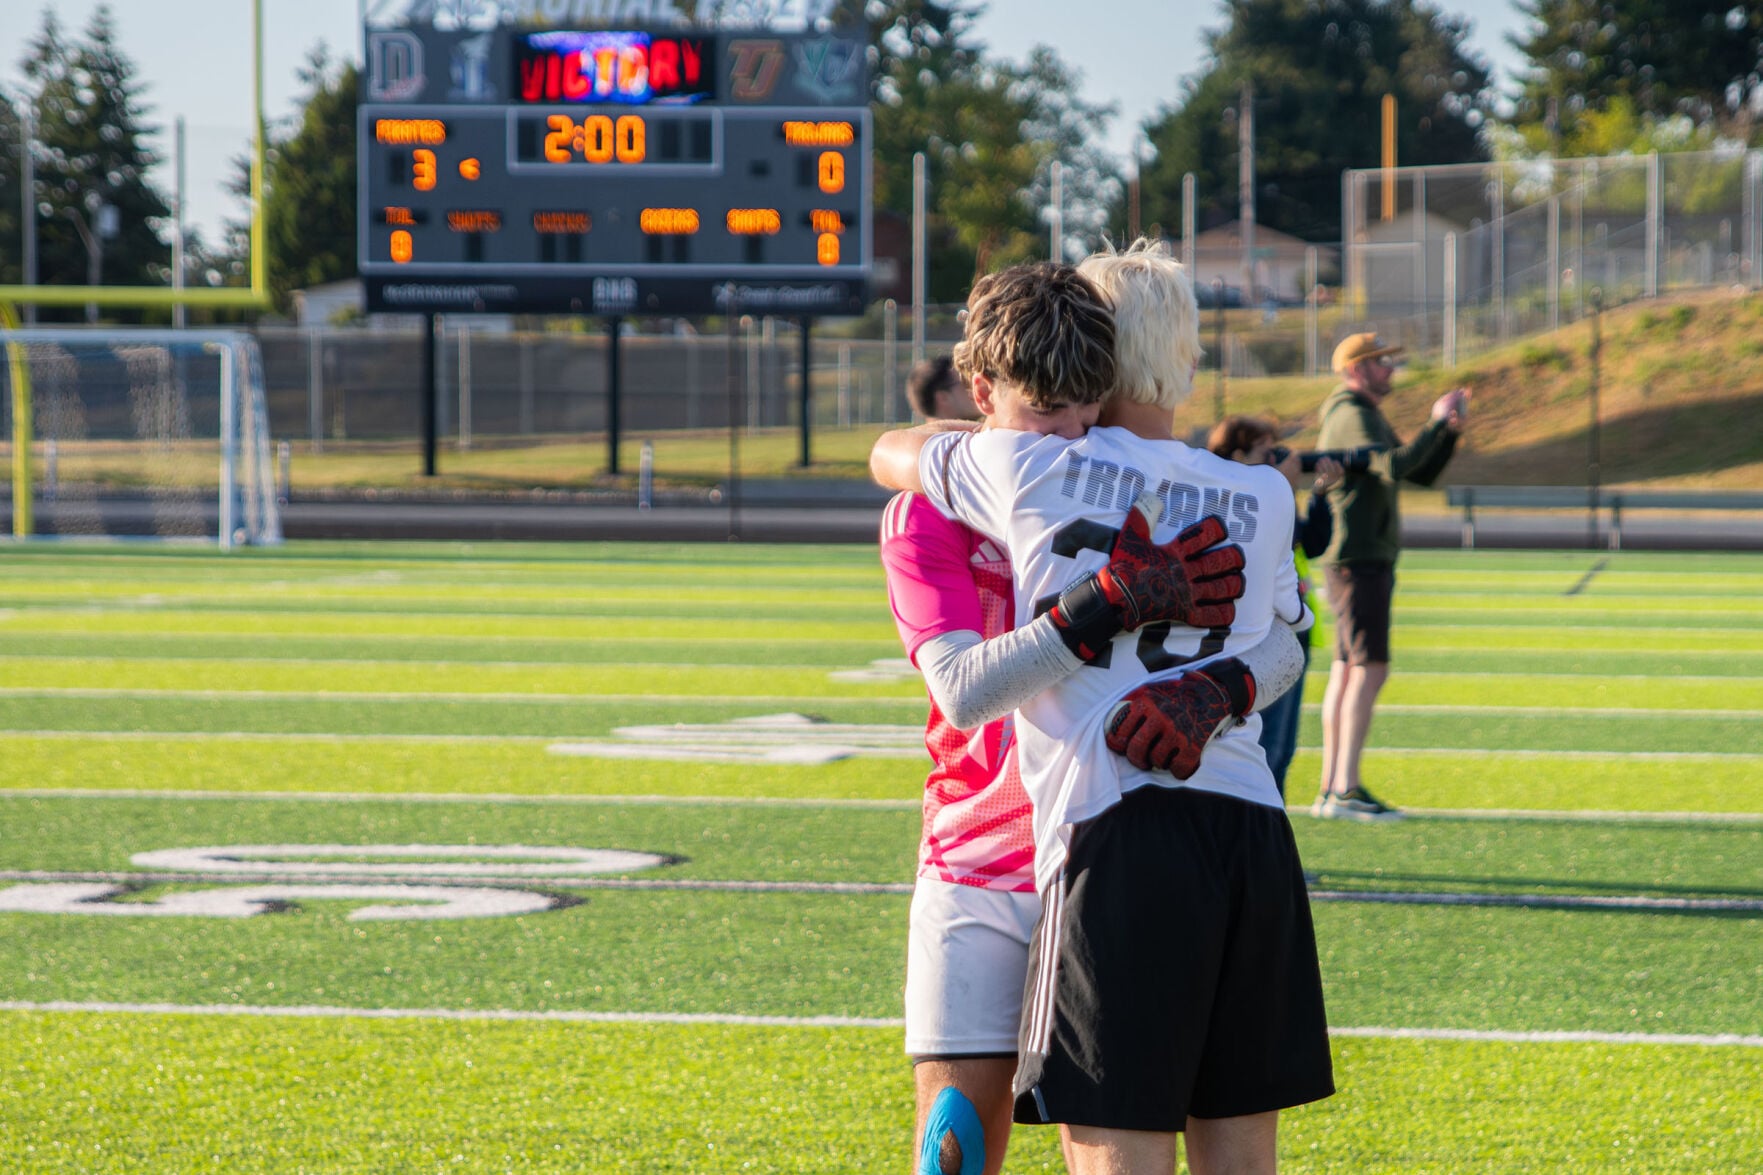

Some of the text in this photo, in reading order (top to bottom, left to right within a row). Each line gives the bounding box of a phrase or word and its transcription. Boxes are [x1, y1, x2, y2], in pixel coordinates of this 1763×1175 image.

[521, 38, 702, 101] VICTORY
[544, 115, 646, 164] 2:00
[413, 148, 437, 191] 3
[818, 151, 845, 194] 0
